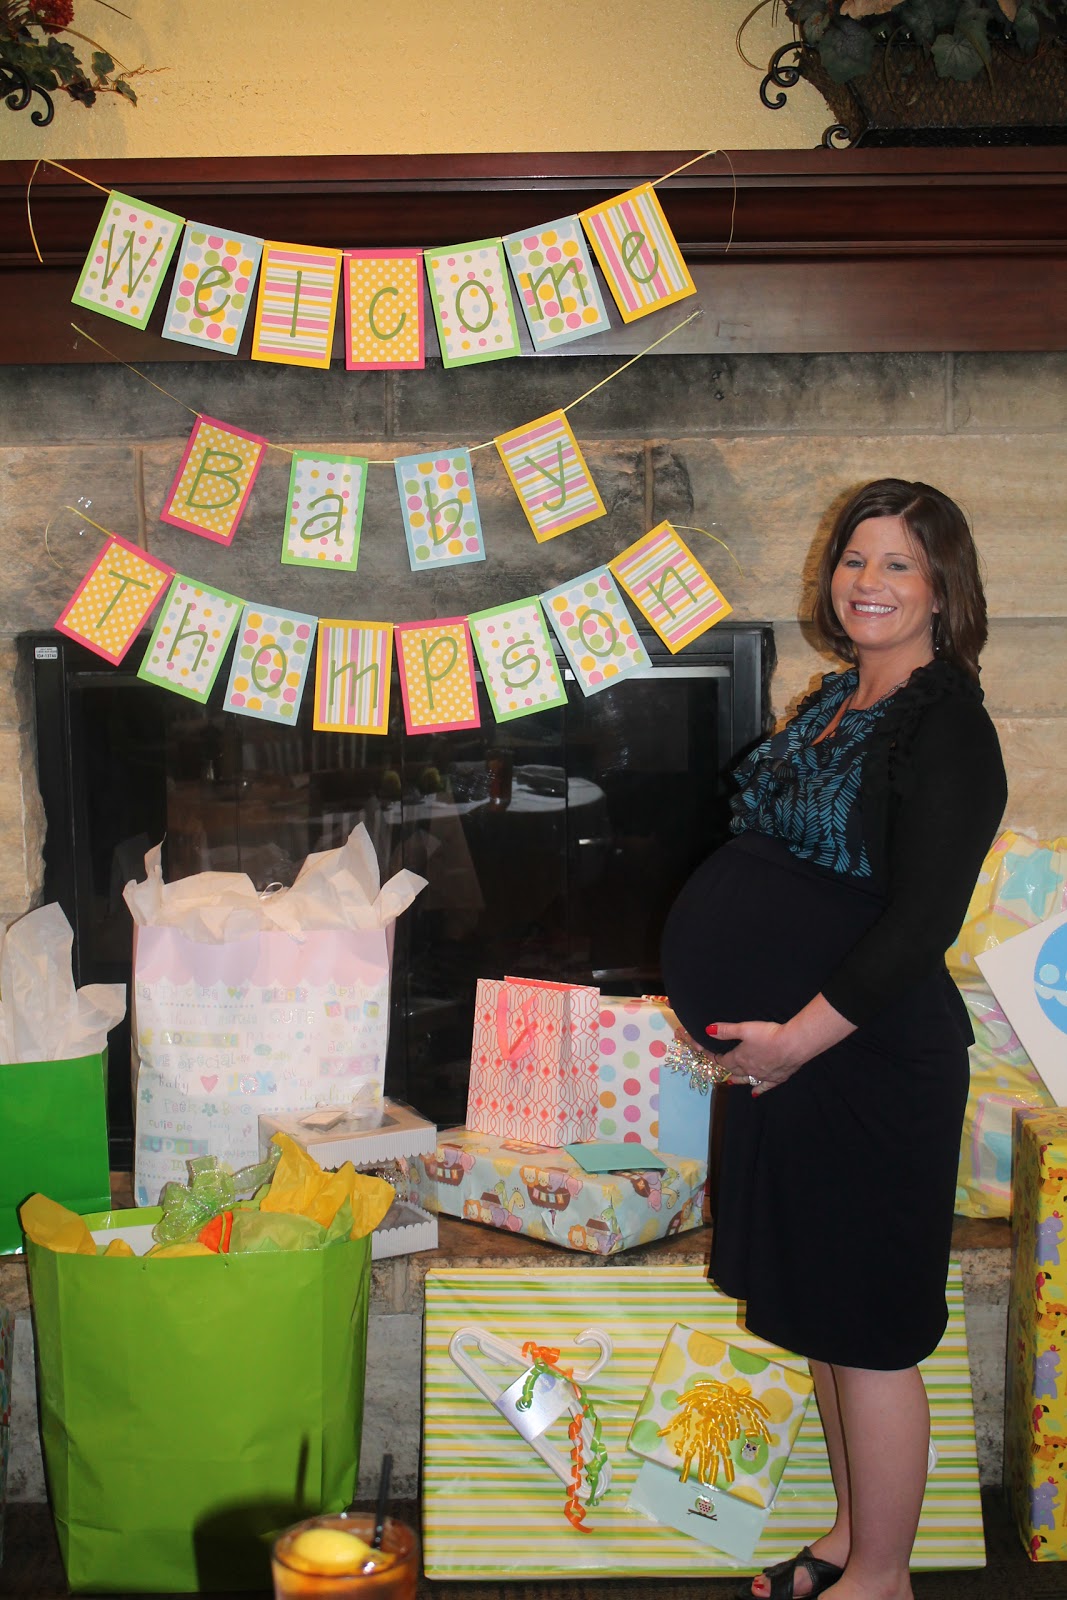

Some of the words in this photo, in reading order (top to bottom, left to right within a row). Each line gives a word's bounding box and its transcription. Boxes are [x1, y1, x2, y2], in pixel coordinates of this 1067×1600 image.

[101, 222, 660, 340] Welcome
[185, 440, 563, 546] Baby
[96, 565, 698, 710] Thompson
